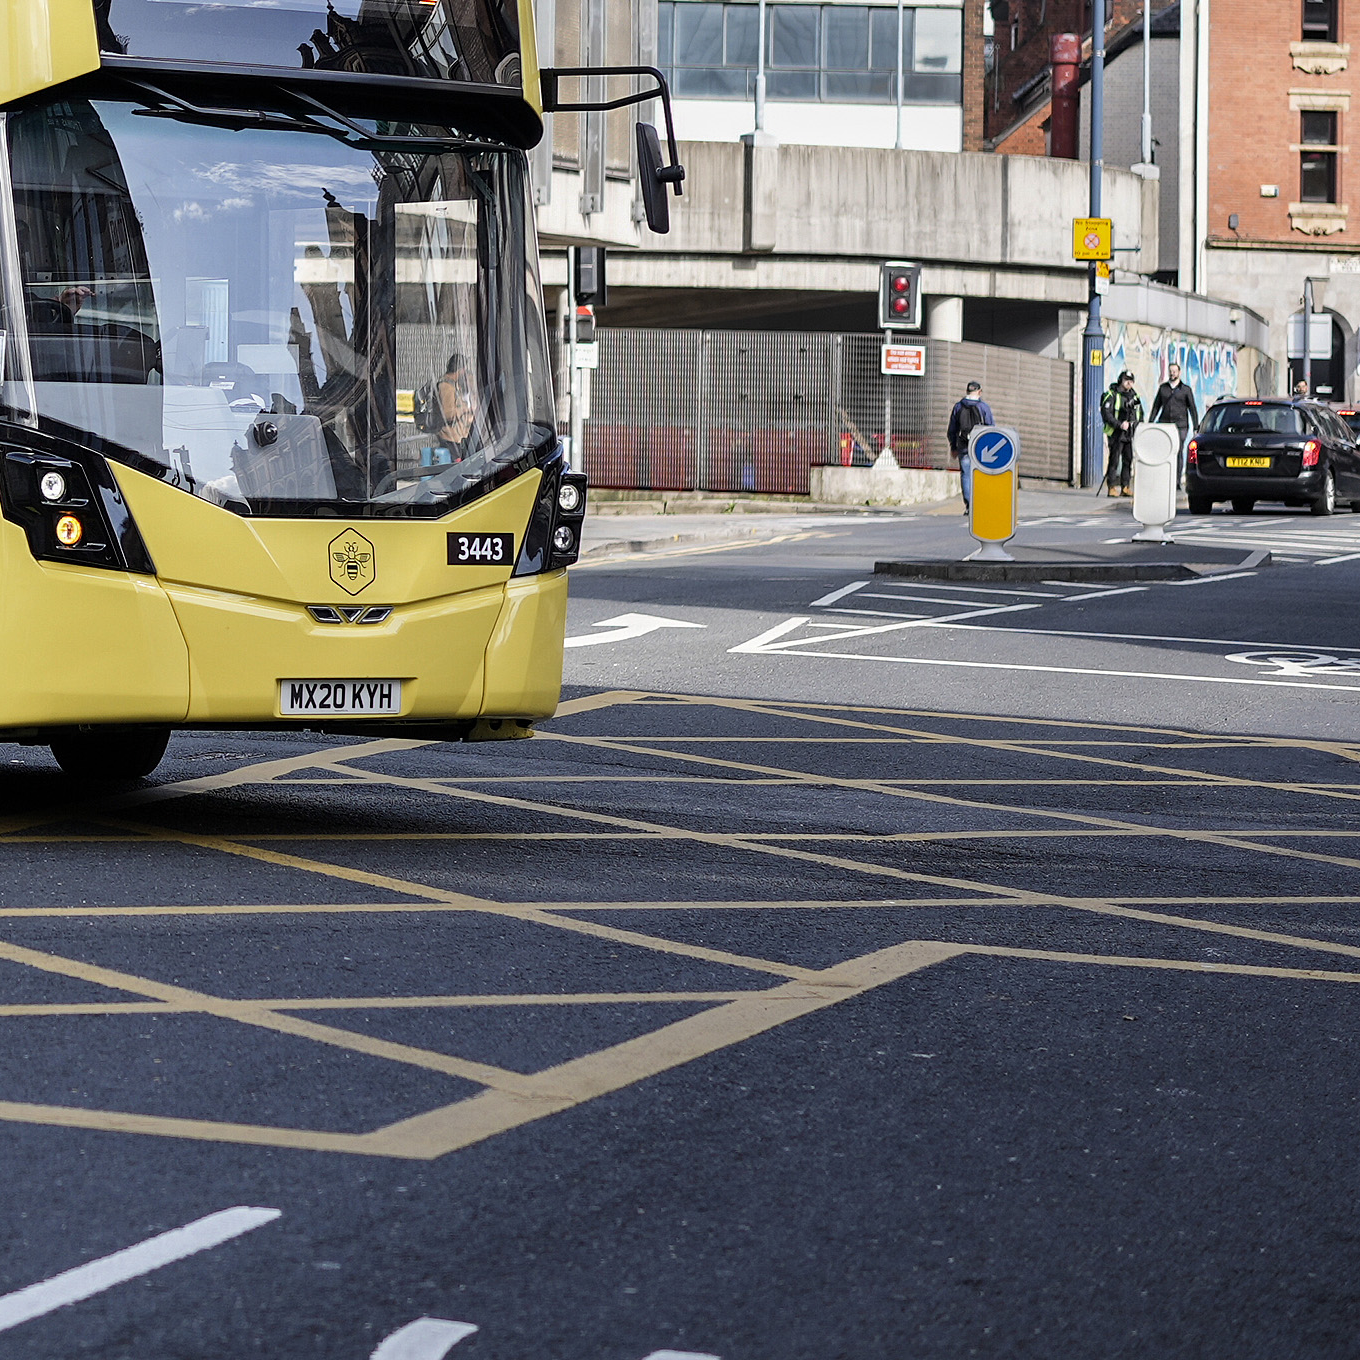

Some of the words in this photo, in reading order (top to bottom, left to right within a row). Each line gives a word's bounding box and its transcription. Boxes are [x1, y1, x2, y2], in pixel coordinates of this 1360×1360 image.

[457, 536, 503, 561] 3443
[290, 683, 346, 710] MX20
[351, 683, 393, 710] KYH
